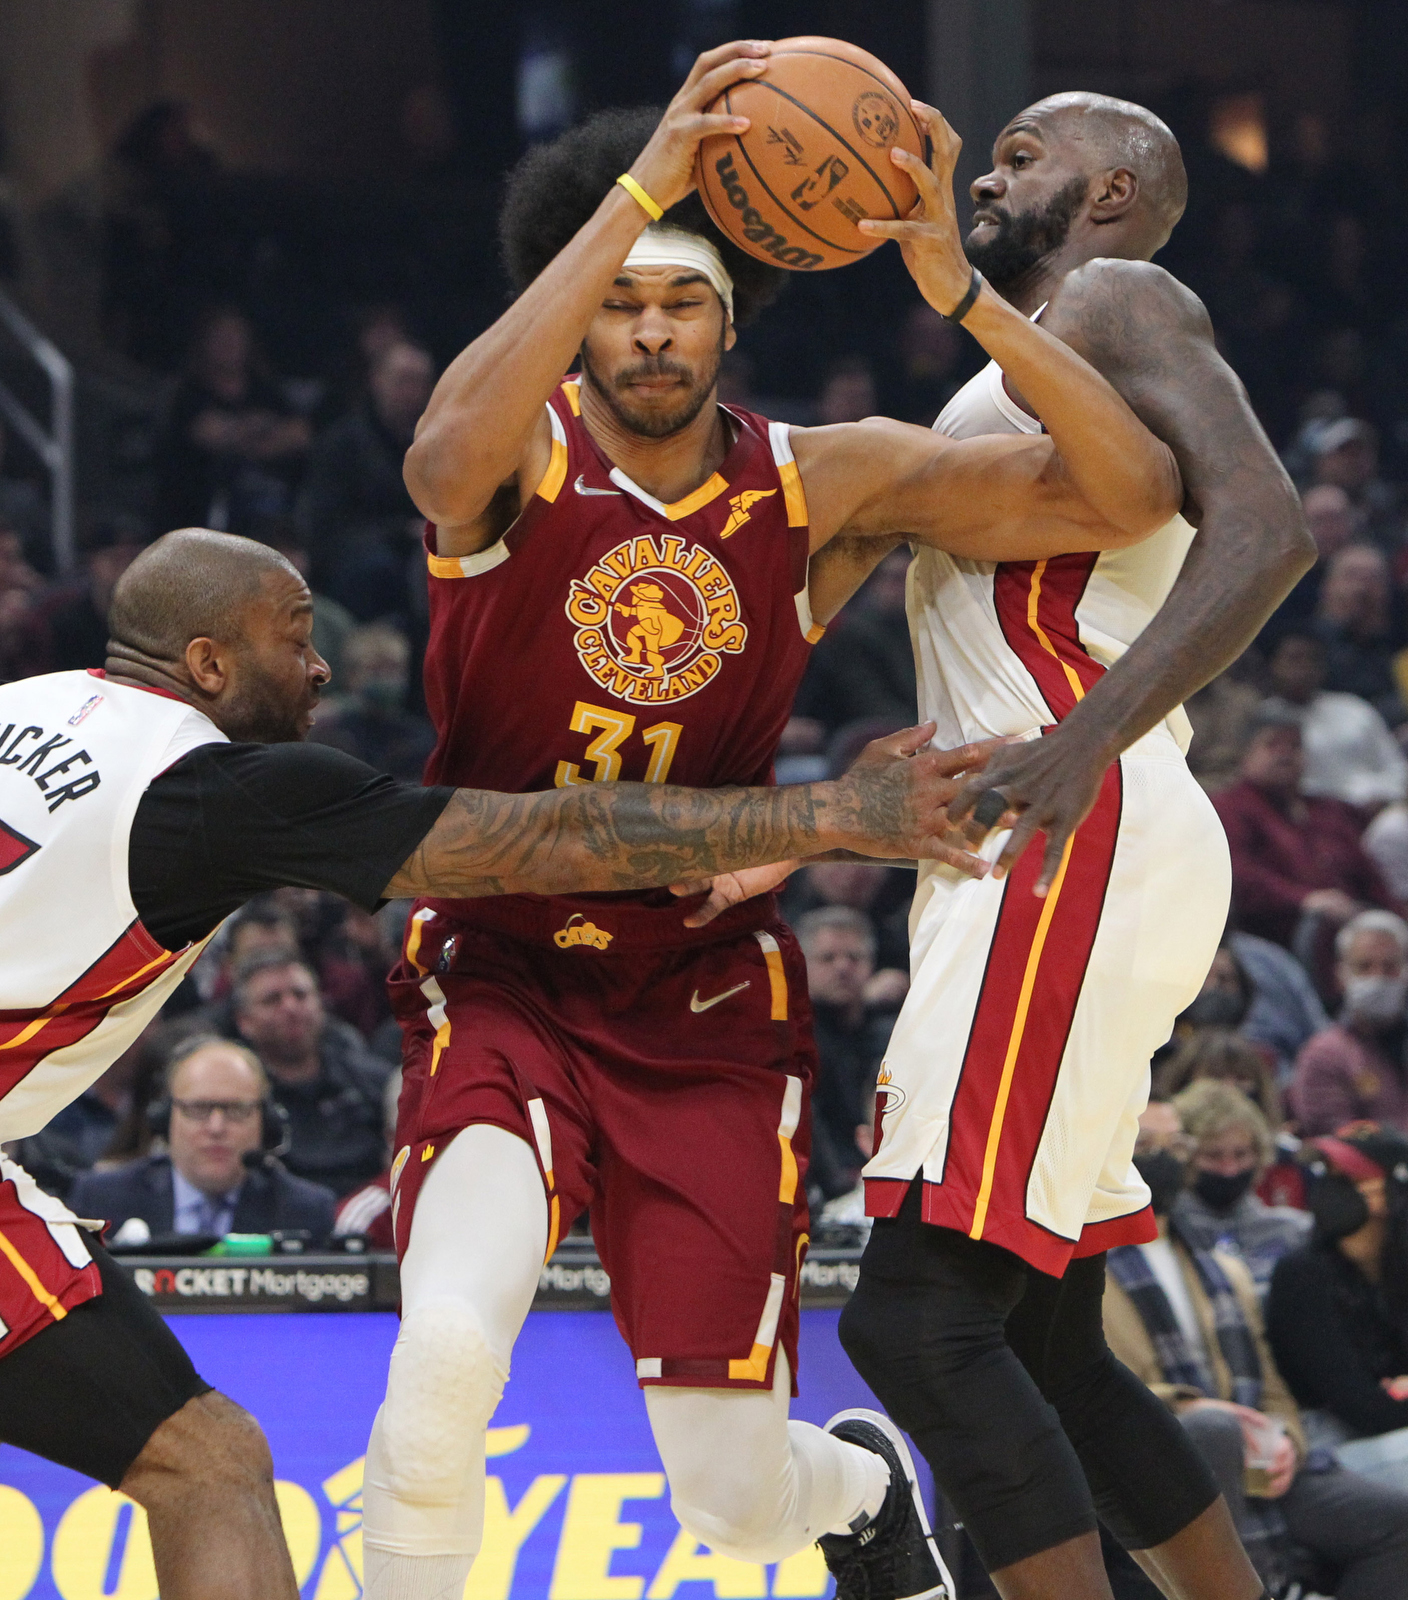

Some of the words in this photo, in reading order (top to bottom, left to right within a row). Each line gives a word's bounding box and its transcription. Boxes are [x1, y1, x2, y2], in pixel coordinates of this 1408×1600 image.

[567, 535, 747, 652] CAVALIERS
[576, 628, 721, 702] CLEVELAND
[554, 700, 684, 788] 31
[250, 1268, 369, 1301] Mortgage
